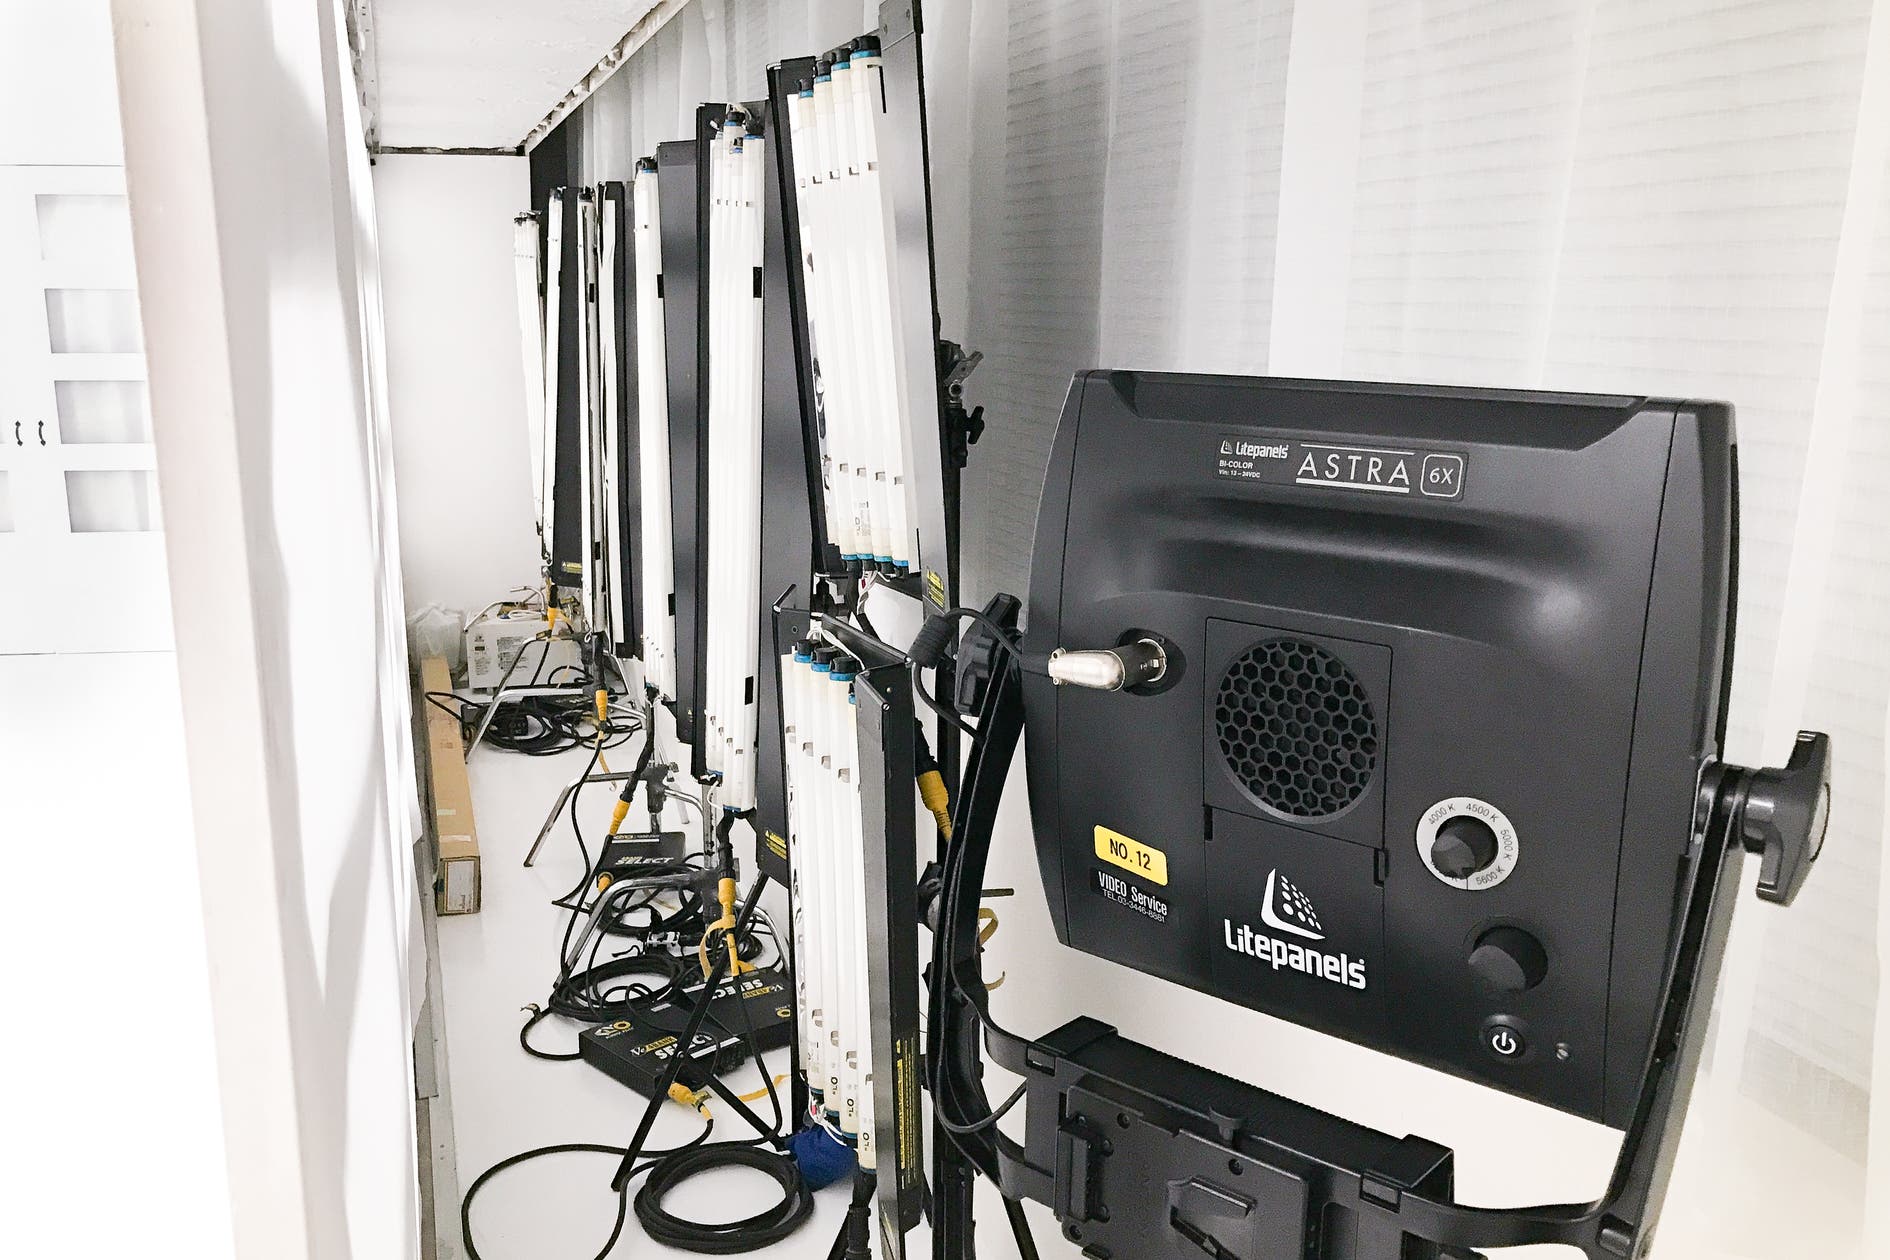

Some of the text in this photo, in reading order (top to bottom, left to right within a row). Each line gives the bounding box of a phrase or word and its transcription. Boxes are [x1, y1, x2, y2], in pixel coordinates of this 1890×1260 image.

[1236, 441, 1289, 459] Litepanels
[1219, 460, 1254, 469] BI-COLOR
[1297, 451, 1454, 485] ASTRA 6X
[1428, 806, 1448, 825] 4000
[1466, 803, 1490, 817] 4500
[1501, 829, 1514, 852] 5000
[1476, 871, 1498, 885] 5600
[1098, 870, 1167, 916] VIDEO Service
[1224, 918, 1367, 990] Litepanels
